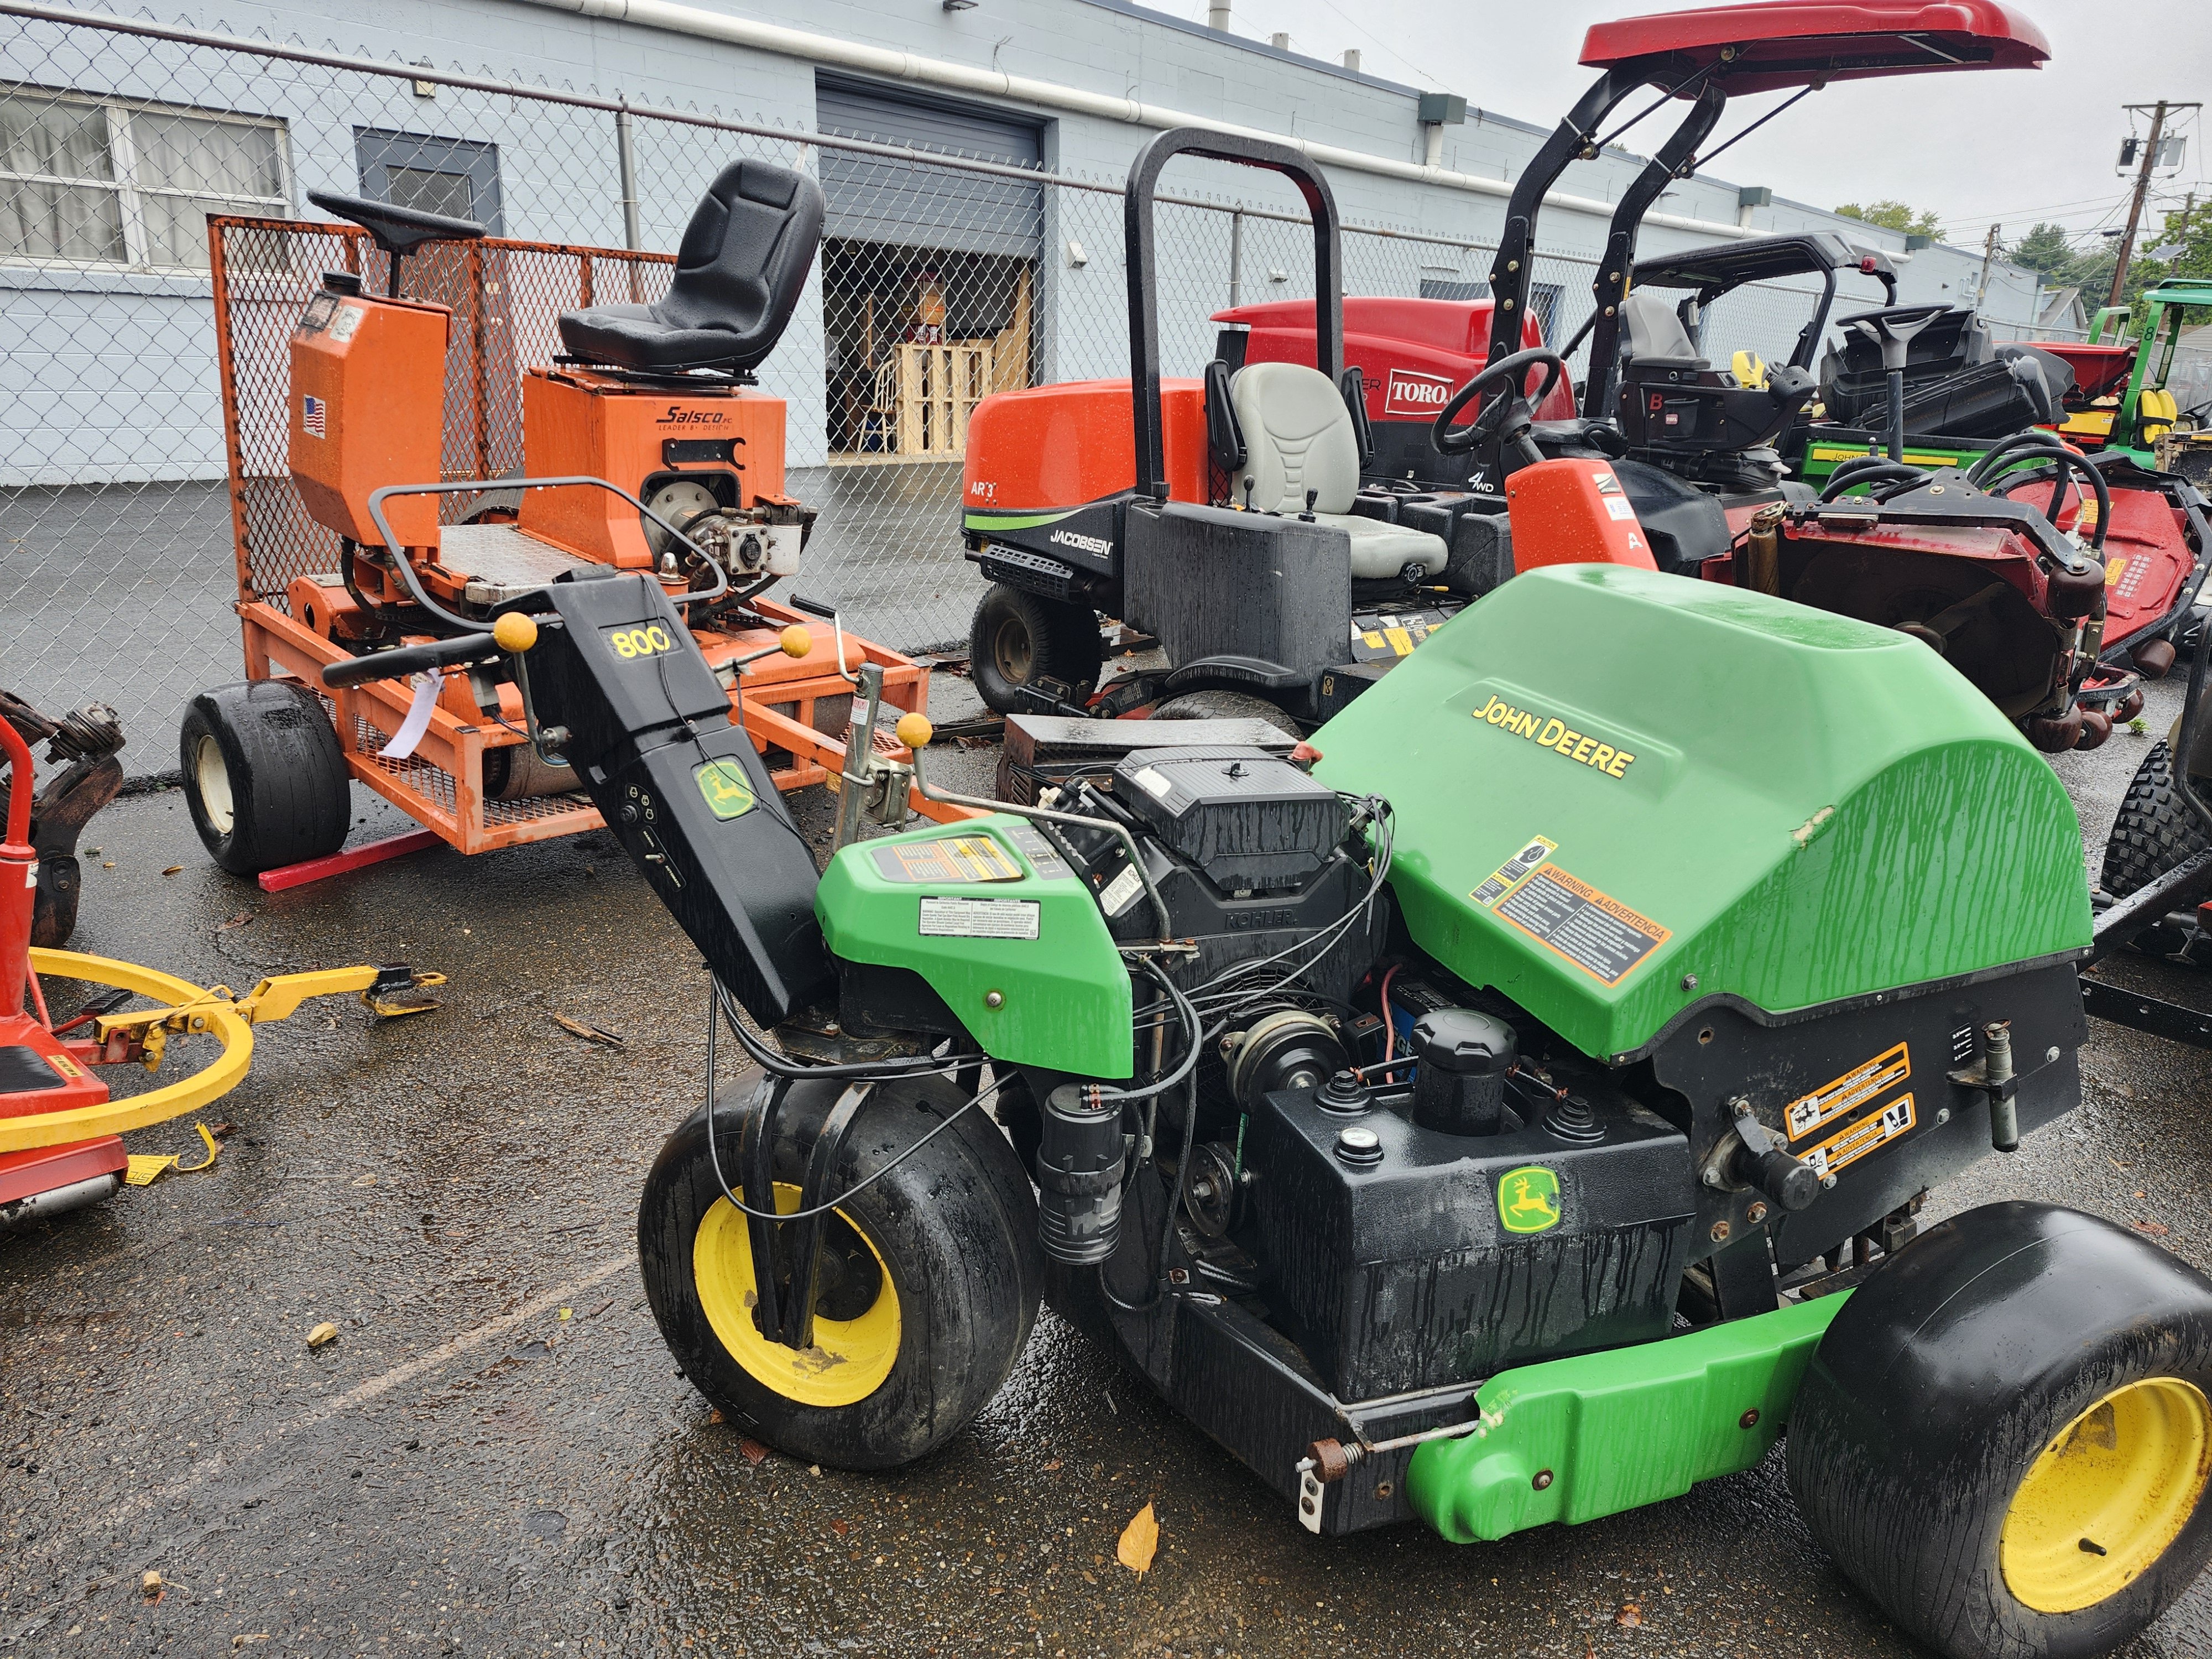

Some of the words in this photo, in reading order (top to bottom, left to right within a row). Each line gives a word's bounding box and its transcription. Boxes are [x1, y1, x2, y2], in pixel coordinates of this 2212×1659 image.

[2144, 326, 2154, 341] 8
[1393, 382, 1447, 404] TORO
[1650, 393, 1663, 410] B
[655, 406, 723, 423] Salsco
[1468, 471, 1494, 492] 4WD
[1051, 529, 1112, 555] JACOBSEN
[1627, 533, 1644, 550] A
[612, 626, 670, 658] 800
[1471, 693, 1543, 740] JOHN
[1535, 717, 1636, 780] DEERE
[643, 831, 655, 848] MANUAL
[665, 865, 681, 888] AUTOMATIC
[1550, 870, 1594, 898] WARNING
[1600, 899, 1666, 939] ADVERTENCIA
[1225, 909, 1293, 930] KOHLER
[1850, 1060, 1876, 1077] WARNING
[1847, 1072, 1883, 1097] ADVERTENCIA
[1843, 1119, 1869, 1138] WARNING
[1842, 1130, 1877, 1154] ADVERTENCIA
